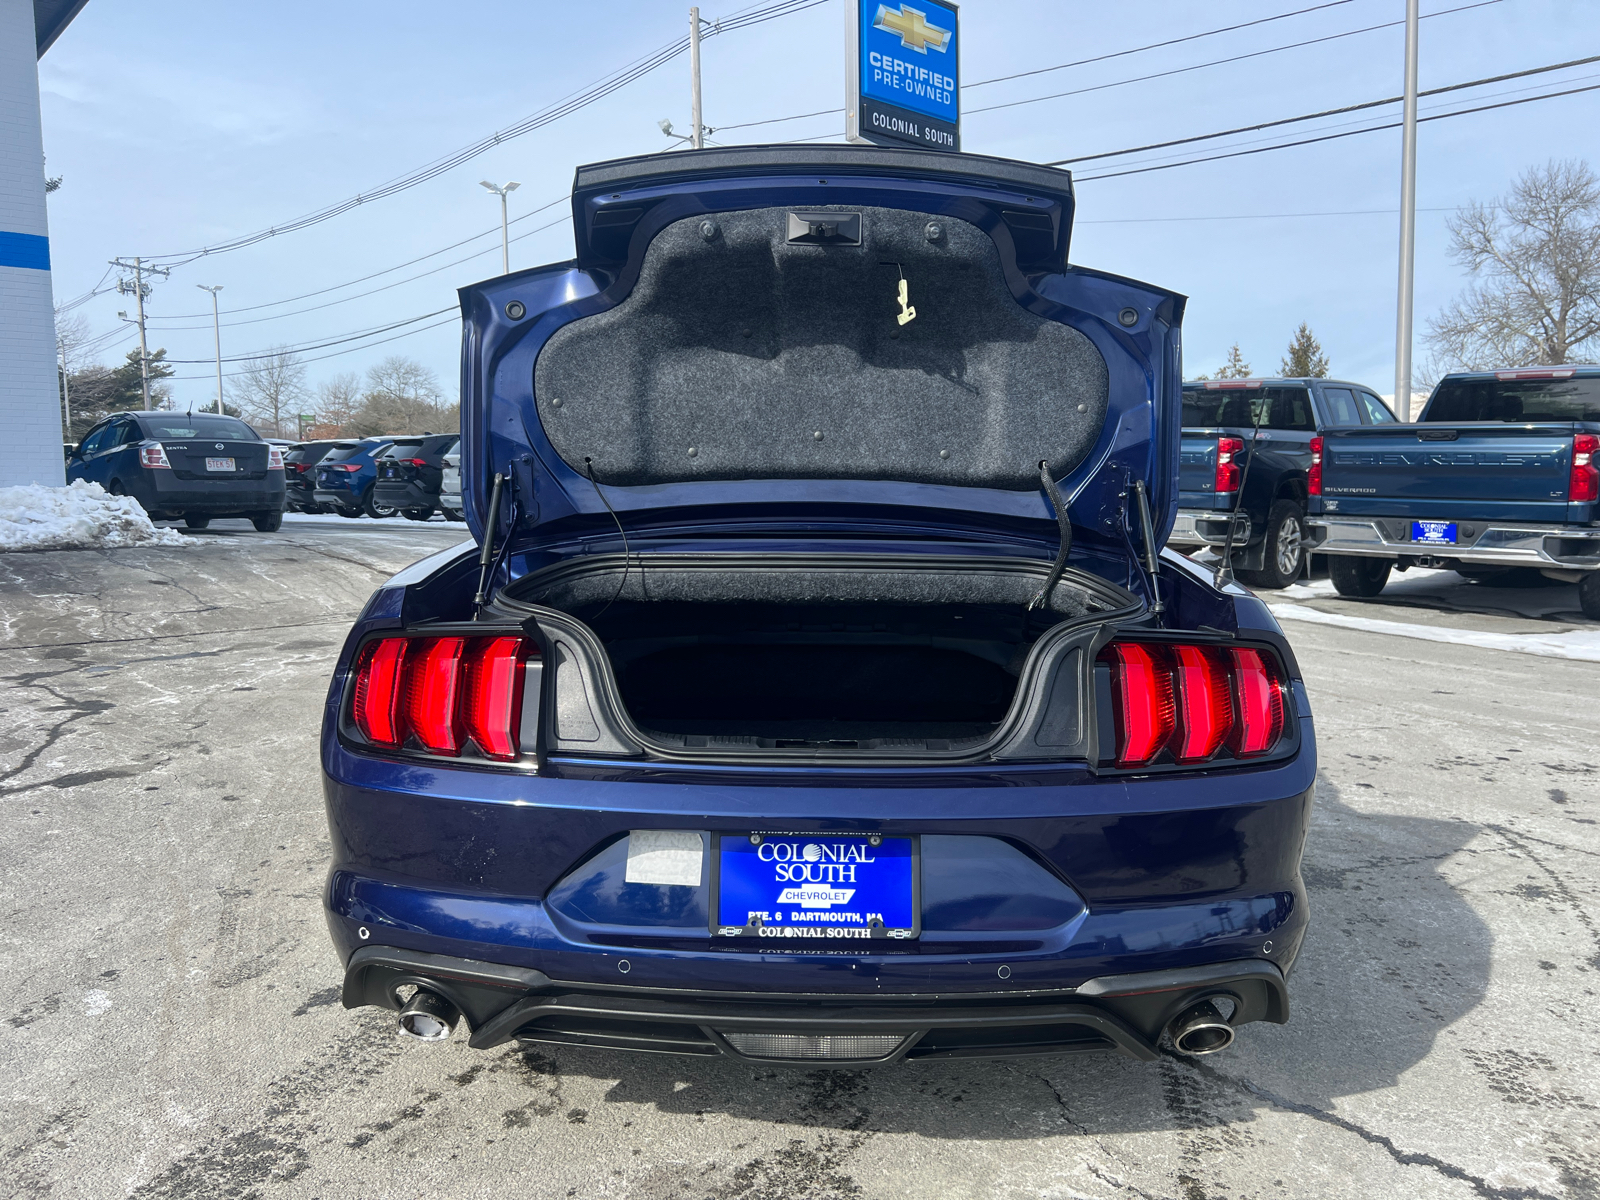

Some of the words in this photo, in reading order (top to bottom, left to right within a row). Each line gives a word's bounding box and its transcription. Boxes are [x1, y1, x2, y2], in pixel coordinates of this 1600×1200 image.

[870, 51, 954, 91] CERTIFIED
[874, 69, 951, 105] PRE-OWNED
[872, 112, 920, 137] COLONIAL
[925, 127, 954, 146] SOUTH
[1335, 454, 1552, 466] CHEVROLET
[758, 843, 875, 863] COLONIAL
[775, 863, 857, 882] SOUTH
[785, 891, 847, 901] CHEVROLET
[775, 911, 783, 921] 6
[791, 912, 864, 924] DARTMOUTH,
[759, 927, 825, 938] COLONIAL
[826, 928, 871, 939] SOUTH
